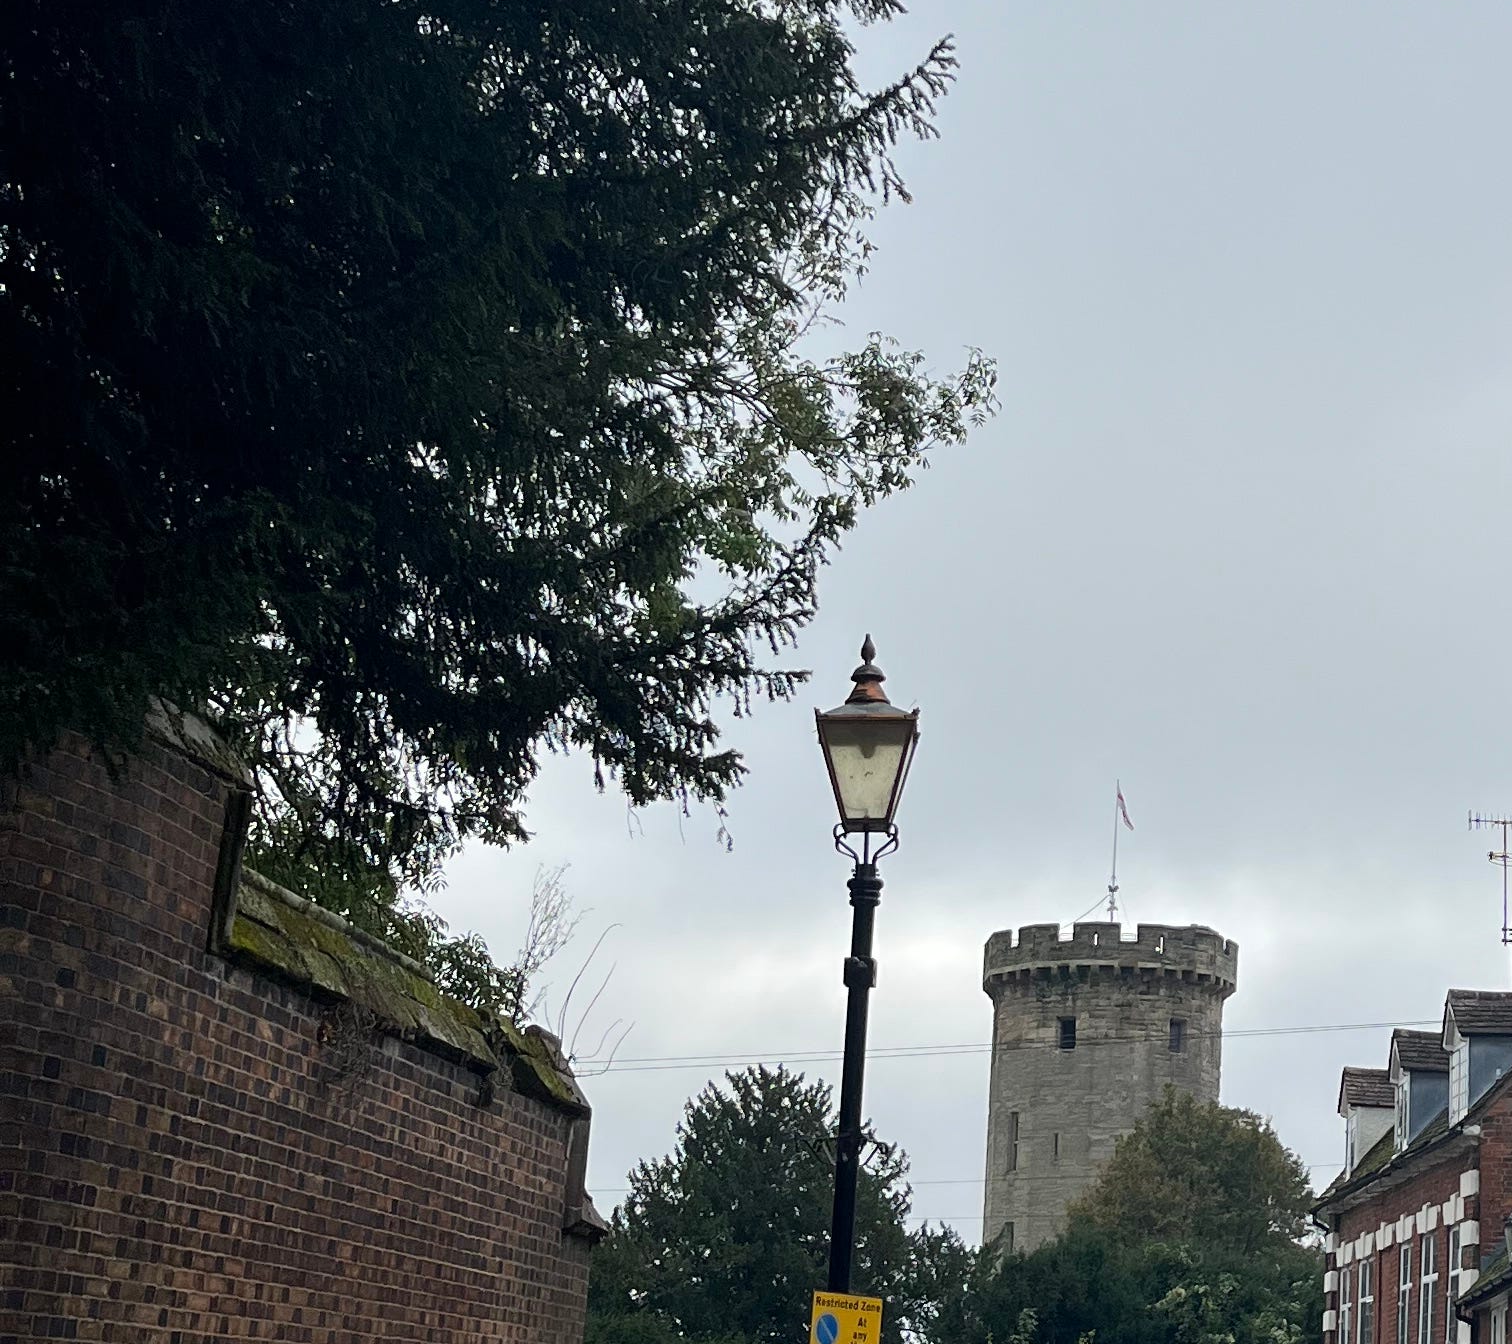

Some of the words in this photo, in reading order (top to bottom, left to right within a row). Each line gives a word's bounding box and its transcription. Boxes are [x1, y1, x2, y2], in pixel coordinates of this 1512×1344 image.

[816, 1296, 858, 1310] Restricted
[861, 1301, 880, 1312] Zone
[858, 1317, 867, 1327] At
[853, 1331, 867, 1342] any
